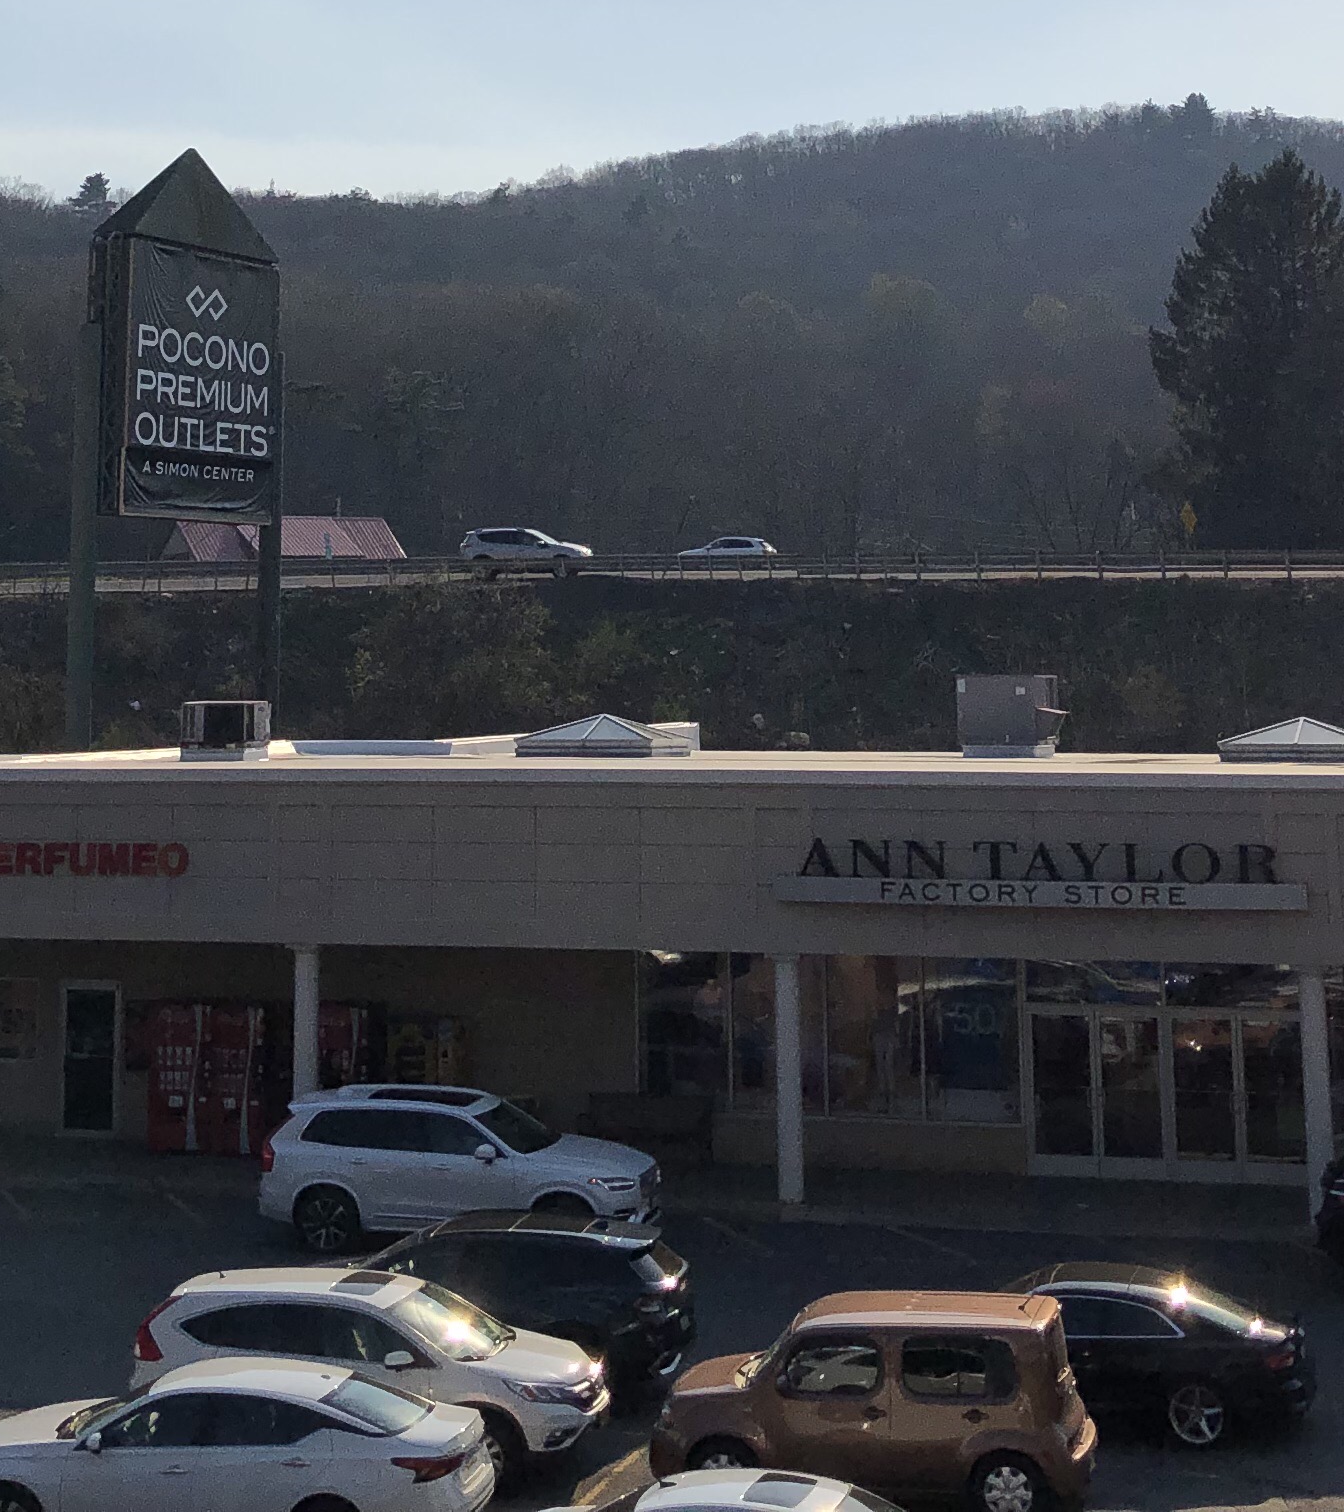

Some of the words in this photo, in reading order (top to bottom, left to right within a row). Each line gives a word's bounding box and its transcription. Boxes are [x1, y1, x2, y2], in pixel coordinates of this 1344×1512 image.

[137, 323, 270, 376] POCONO
[136, 368, 268, 417] PREMIUM
[134, 411, 268, 457] OUTLETS
[142, 460, 152, 474] A
[155, 461, 199, 478] SIMON
[203, 465, 255, 483] CENTER
[800, 837, 946, 880] ANN
[972, 840, 1284, 885] TAYLOR
[880, 881, 1039, 904] FACTORY
[1064, 885, 1188, 906] STORE
